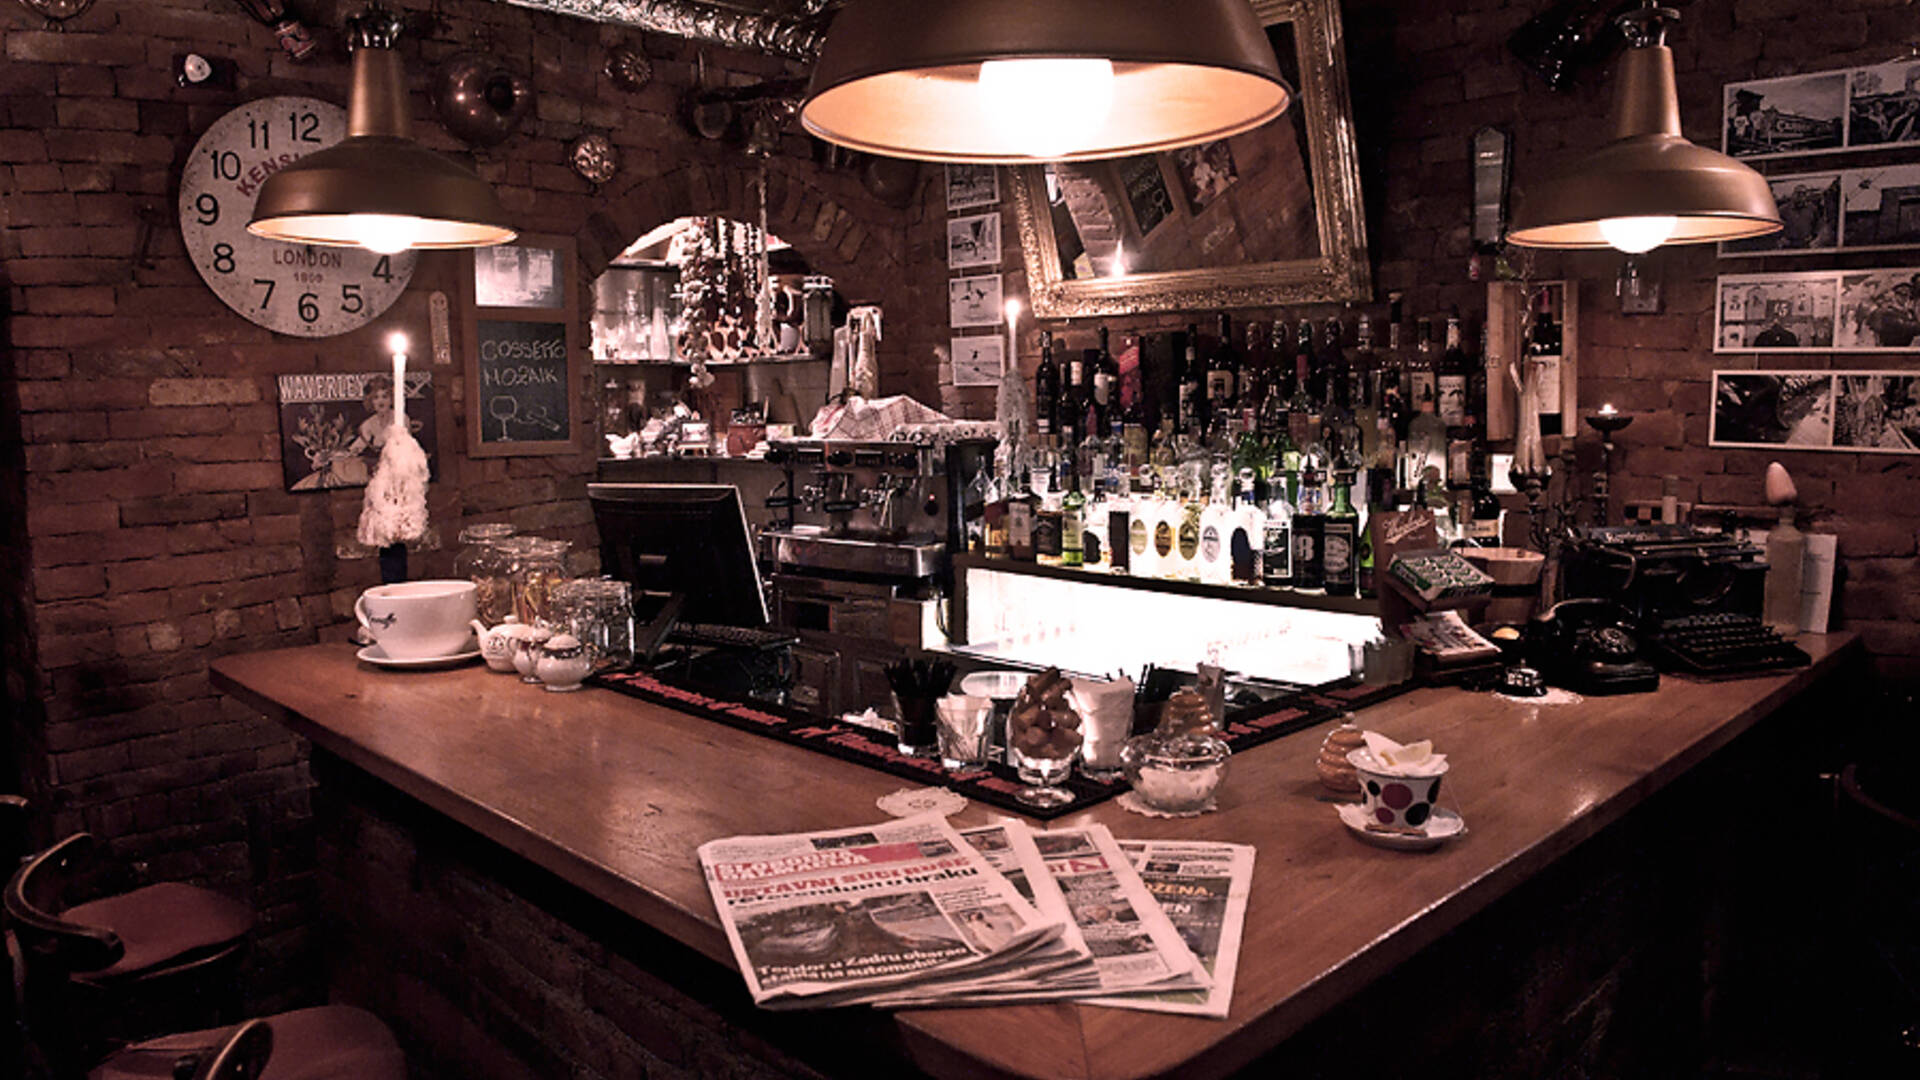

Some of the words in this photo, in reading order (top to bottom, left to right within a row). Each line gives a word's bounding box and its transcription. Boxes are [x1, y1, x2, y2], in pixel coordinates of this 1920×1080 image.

[248, 119, 270, 150] 11
[289, 111, 322, 144] 12
[210, 150, 242, 181] 10
[195, 193, 220, 226] 9
[212, 243, 236, 274] 8
[272, 249, 343, 269] LONDON
[371, 254, 395, 284] 4
[253, 278, 276, 310] 7
[297, 292, 320, 323] 6
[340, 284, 364, 314] 5
[481, 339, 567, 362] COSSETTO
[278, 374, 366, 400] WAVERLEY
